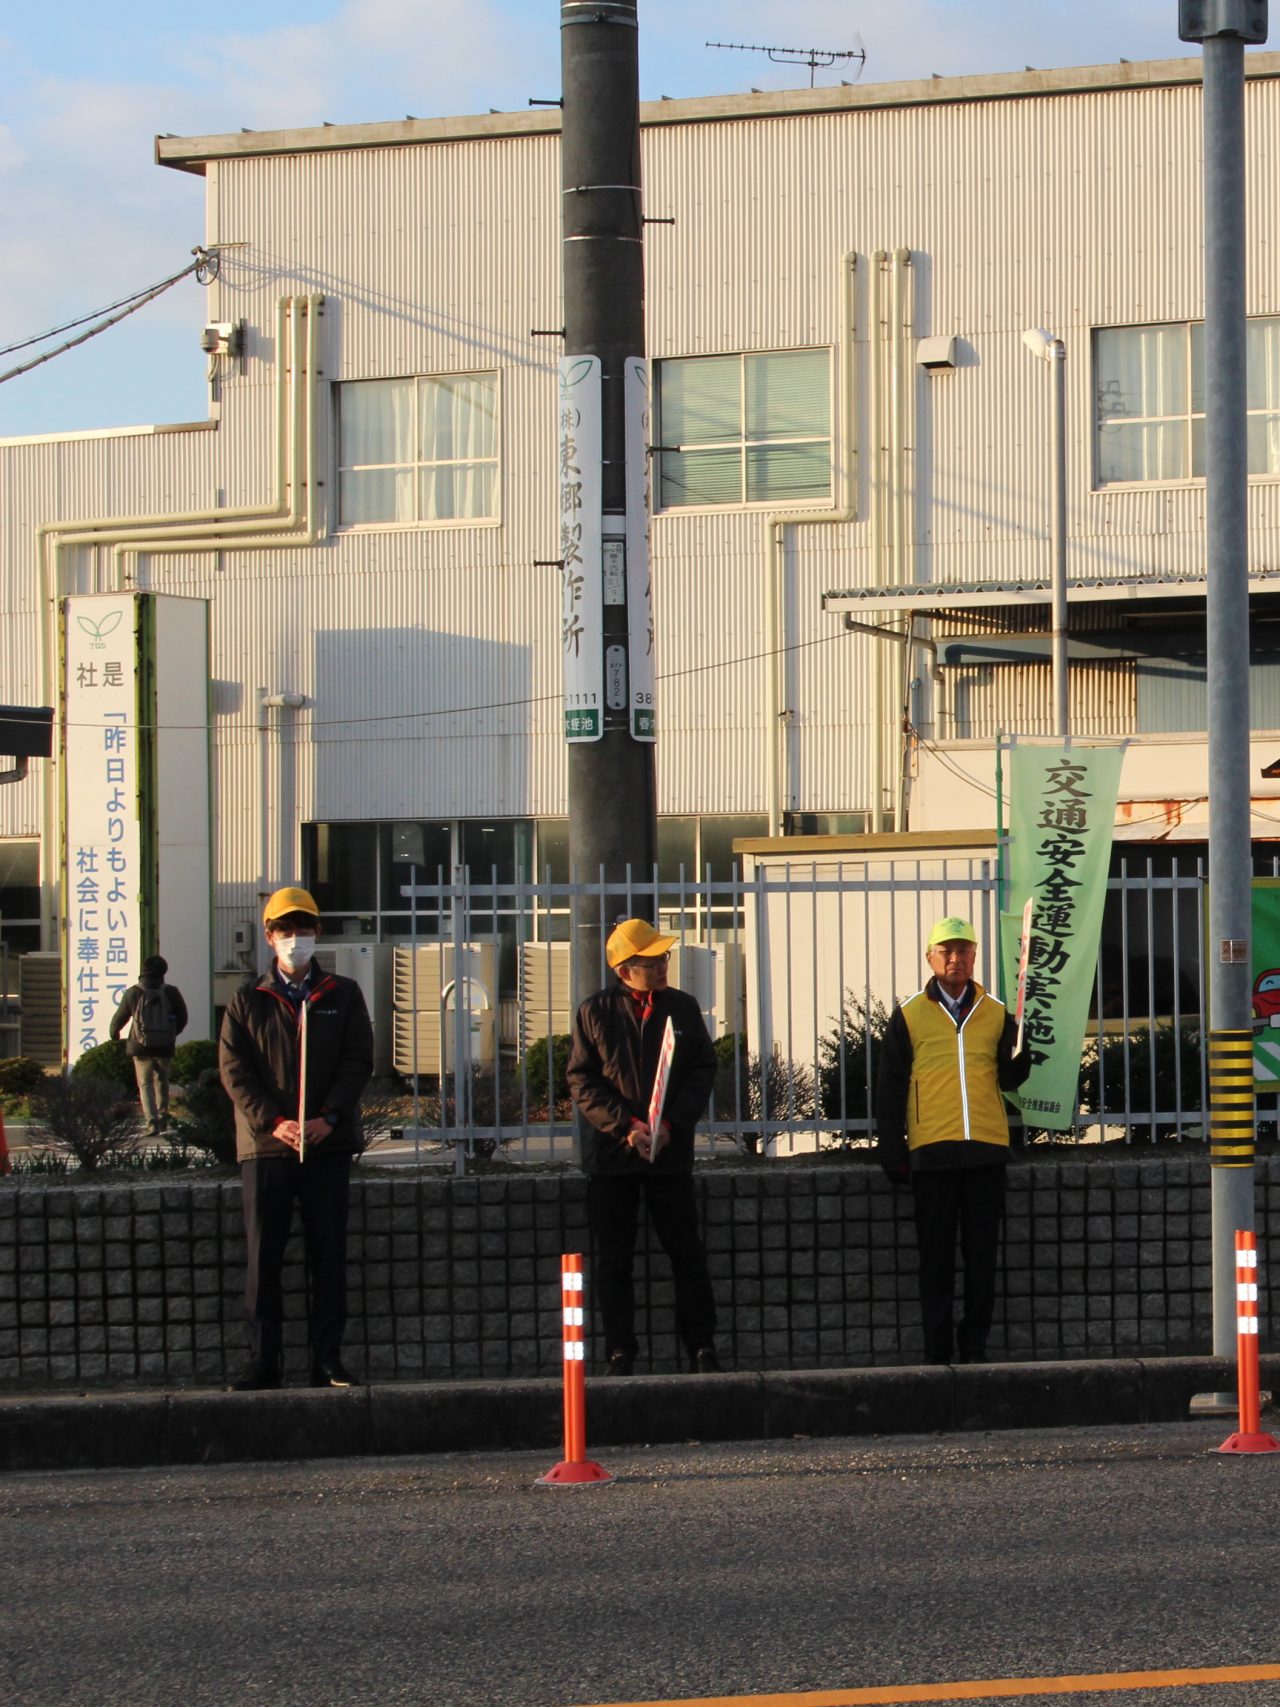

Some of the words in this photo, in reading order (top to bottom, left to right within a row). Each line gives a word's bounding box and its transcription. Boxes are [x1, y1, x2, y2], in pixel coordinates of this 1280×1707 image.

[89, 642, 107, 650] TGS
[76, 662, 124, 689] 社是
[76, 847, 99, 1052] 社会に奉仕する
